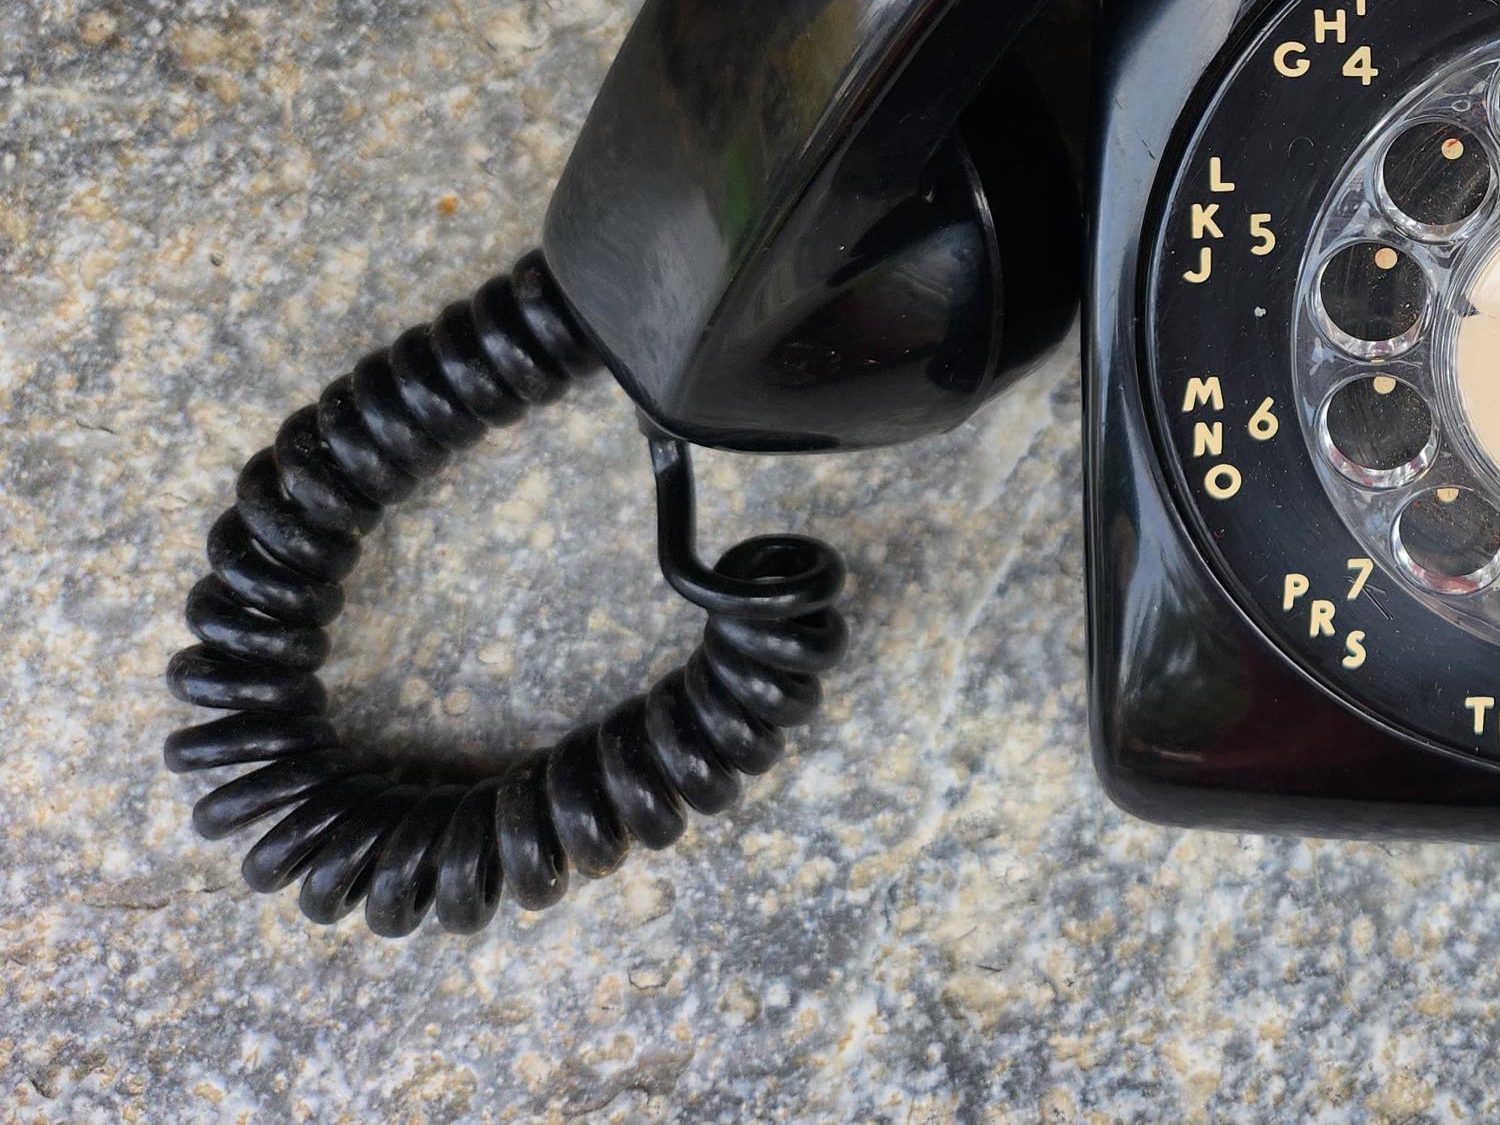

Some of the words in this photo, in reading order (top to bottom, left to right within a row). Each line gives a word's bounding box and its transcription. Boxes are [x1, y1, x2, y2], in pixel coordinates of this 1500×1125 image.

[1342, 45, 1378, 86] 4
[1250, 213, 1276, 256] 5
[1247, 396, 1279, 441] 6
[1344, 558, 1374, 599] 7
